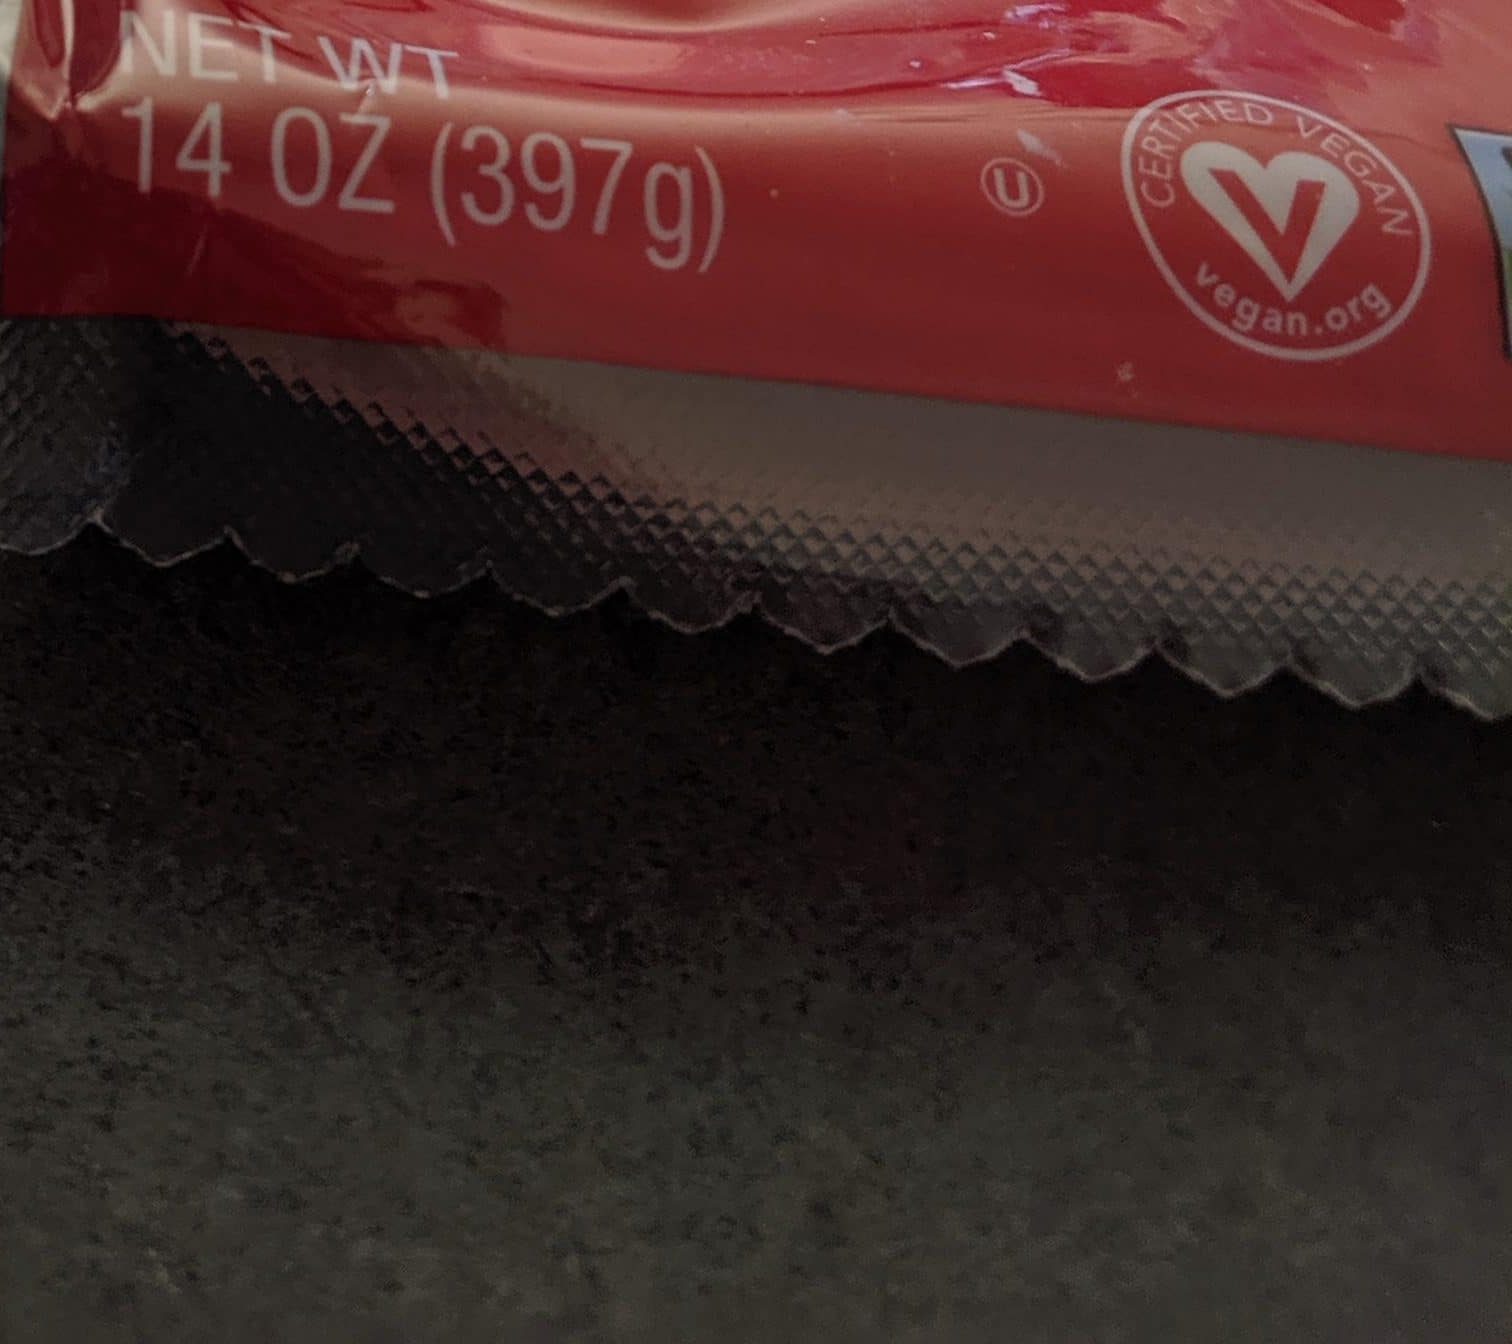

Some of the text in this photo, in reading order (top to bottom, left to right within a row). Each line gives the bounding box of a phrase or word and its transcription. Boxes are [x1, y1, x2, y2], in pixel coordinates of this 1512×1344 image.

[122, 10, 459, 100] NET WT
[123, 100, 726, 275] 14 OZ (397g)
[1137, 99, 1414, 238] CERTIFIED VEGAN
[1194, 260, 1394, 337] vegan.org
